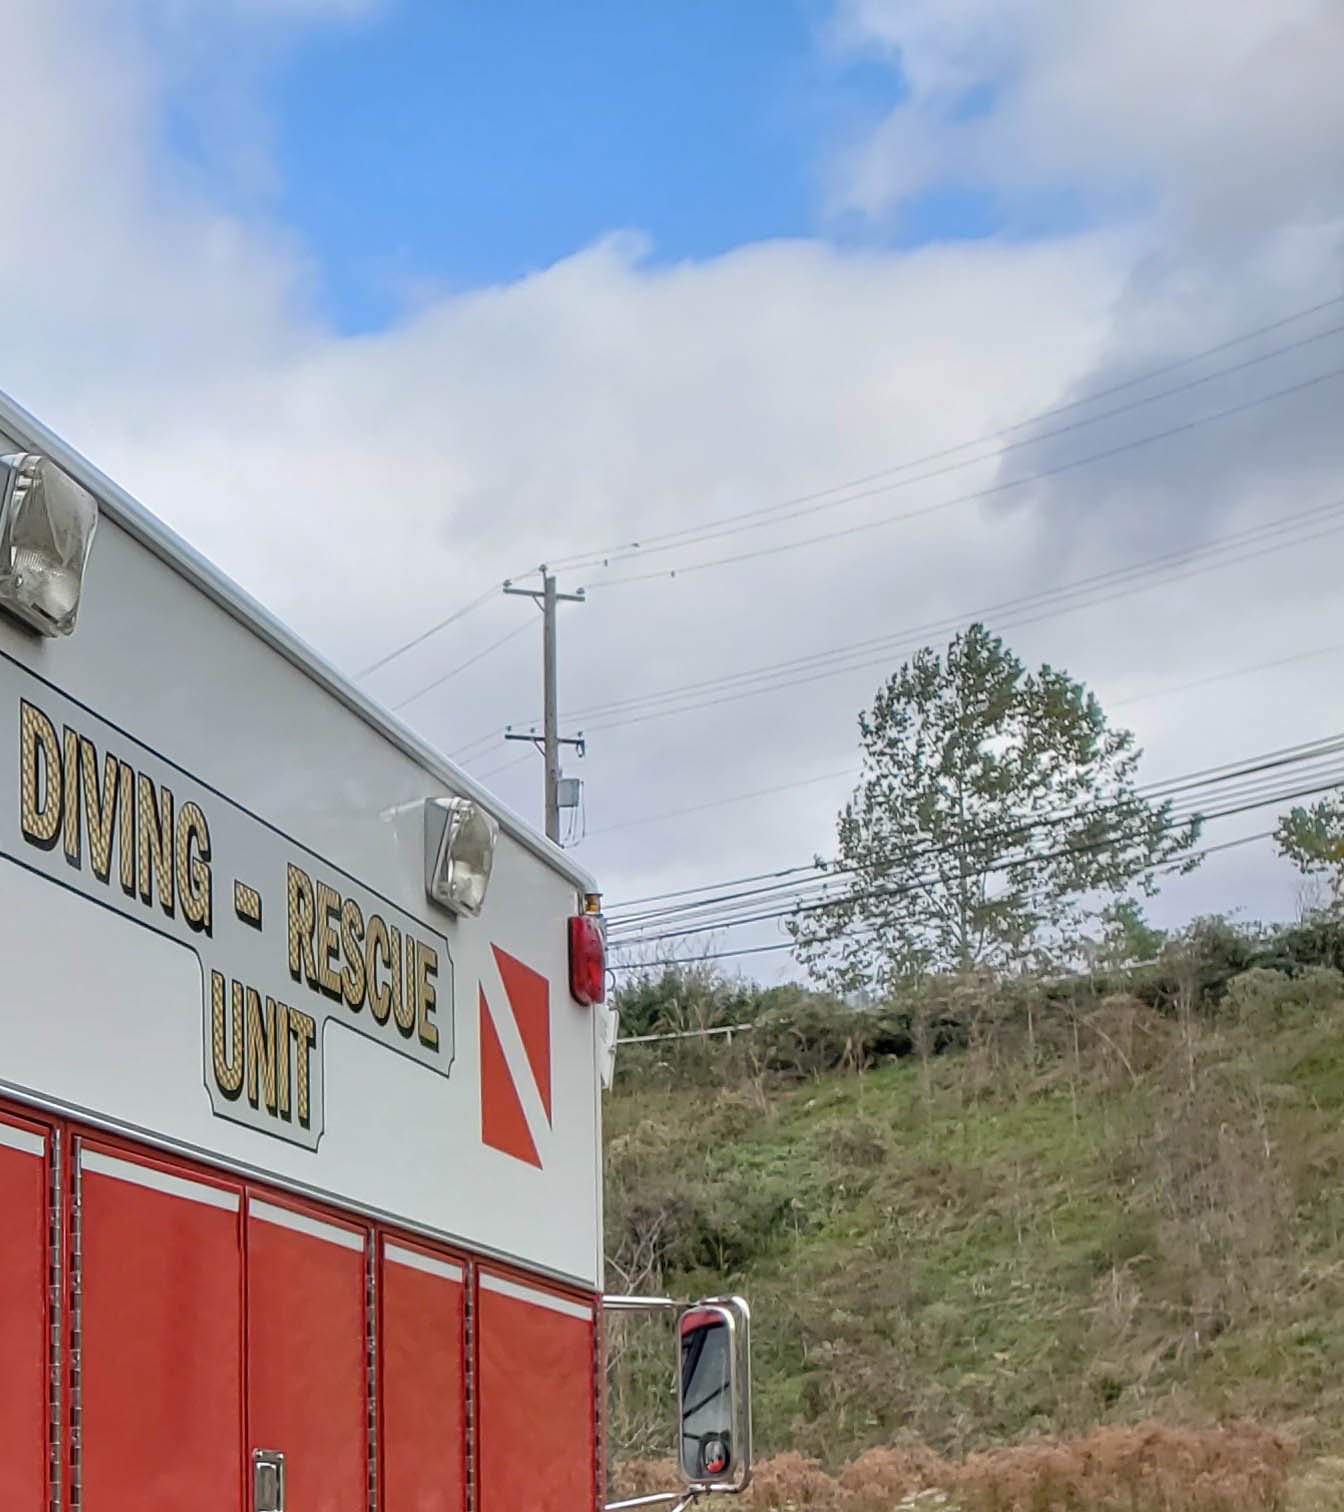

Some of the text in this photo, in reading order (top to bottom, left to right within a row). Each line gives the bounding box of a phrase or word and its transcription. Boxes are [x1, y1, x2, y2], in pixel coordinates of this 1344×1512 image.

[20, 697, 213, 939] DIVING
[287, 862, 439, 1053] RESCUE
[211, 968, 316, 1131] UNIT
